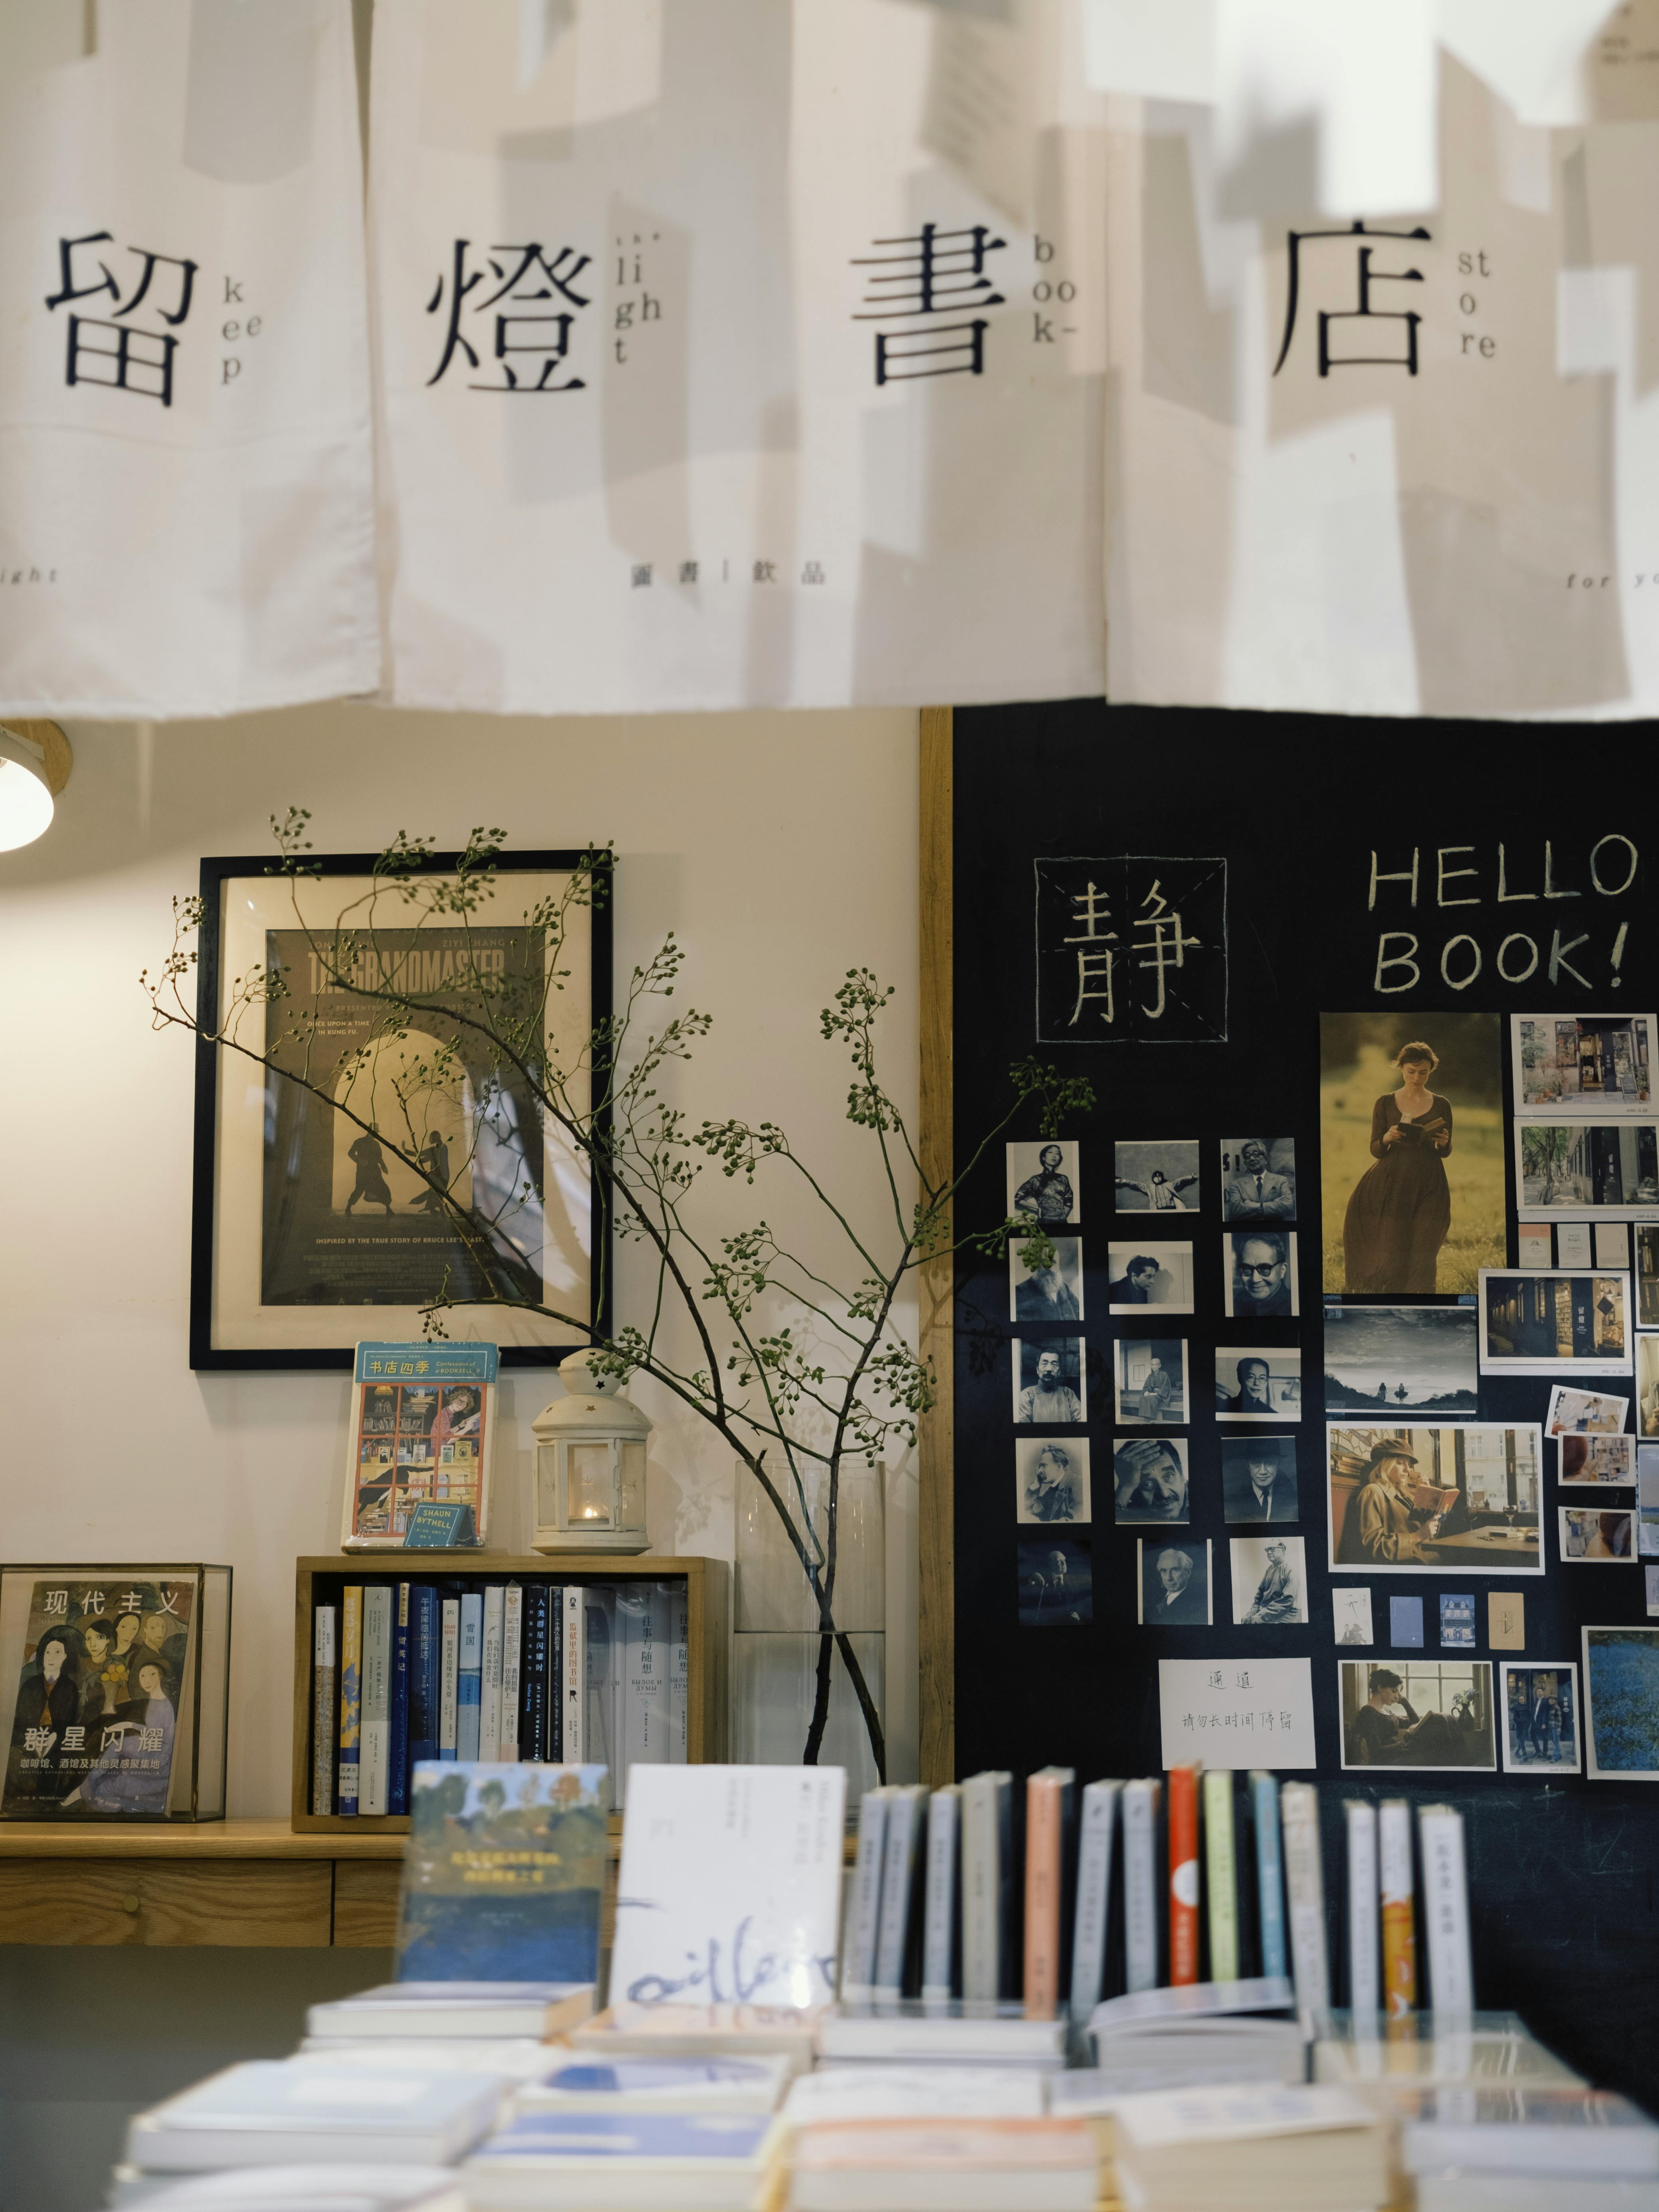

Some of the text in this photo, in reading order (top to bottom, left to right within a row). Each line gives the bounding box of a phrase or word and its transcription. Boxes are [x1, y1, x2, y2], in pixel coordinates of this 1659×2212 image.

[1567, 573, 1610, 588] for
[1368, 834, 1639, 912] HELLO
[1062, 878, 1201, 1026] 静
[1373, 921, 1629, 995] BOOK!
[351, 949, 504, 993] GRANDMASTER
[369, 1360, 430, 1375] 书店四季
[416, 1516, 451, 1529] BYTHELL
[423, 1509, 451, 1518] SHAUN
[43, 1590, 179, 1615] 现代主义
[465, 1623, 475, 1645] 雪国
[536, 1599, 545, 1671] 人类群星闪耀时
[641, 1615, 653, 1674] 往事与随想
[398, 1636, 406, 1671] 留英记
[569, 1622, 577, 1686] 监狱里的图书馆
[1208, 1670, 1255, 1690] 通道
[1182, 1709, 1292, 1731] 请勿长时间停留
[23, 1726, 164, 1753] 群星闪耀
[20, 1758, 160, 1769] 咖啡馆、酒馆及其他灵感聚集地
